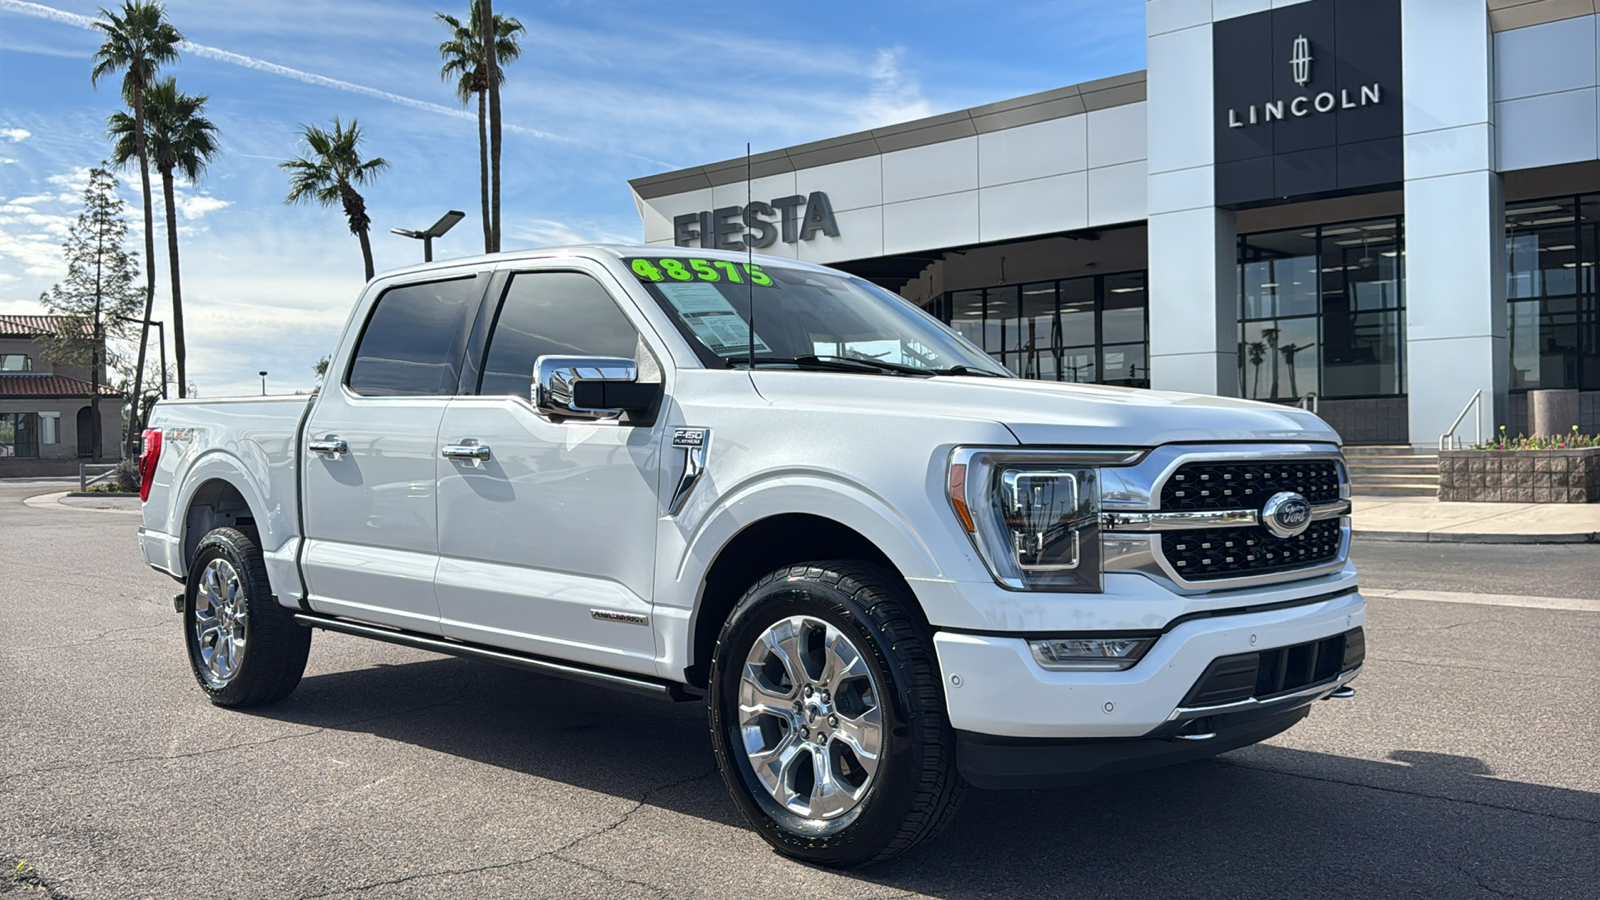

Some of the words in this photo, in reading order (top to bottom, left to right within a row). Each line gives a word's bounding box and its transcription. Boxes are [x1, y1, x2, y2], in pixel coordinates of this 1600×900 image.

[1228, 83, 1380, 128] LINCOLN
[673, 191, 841, 250] FIESTA
[631, 258, 774, 286] 48575
[674, 430, 703, 439] F-150
[1282, 502, 1306, 524] Ford
